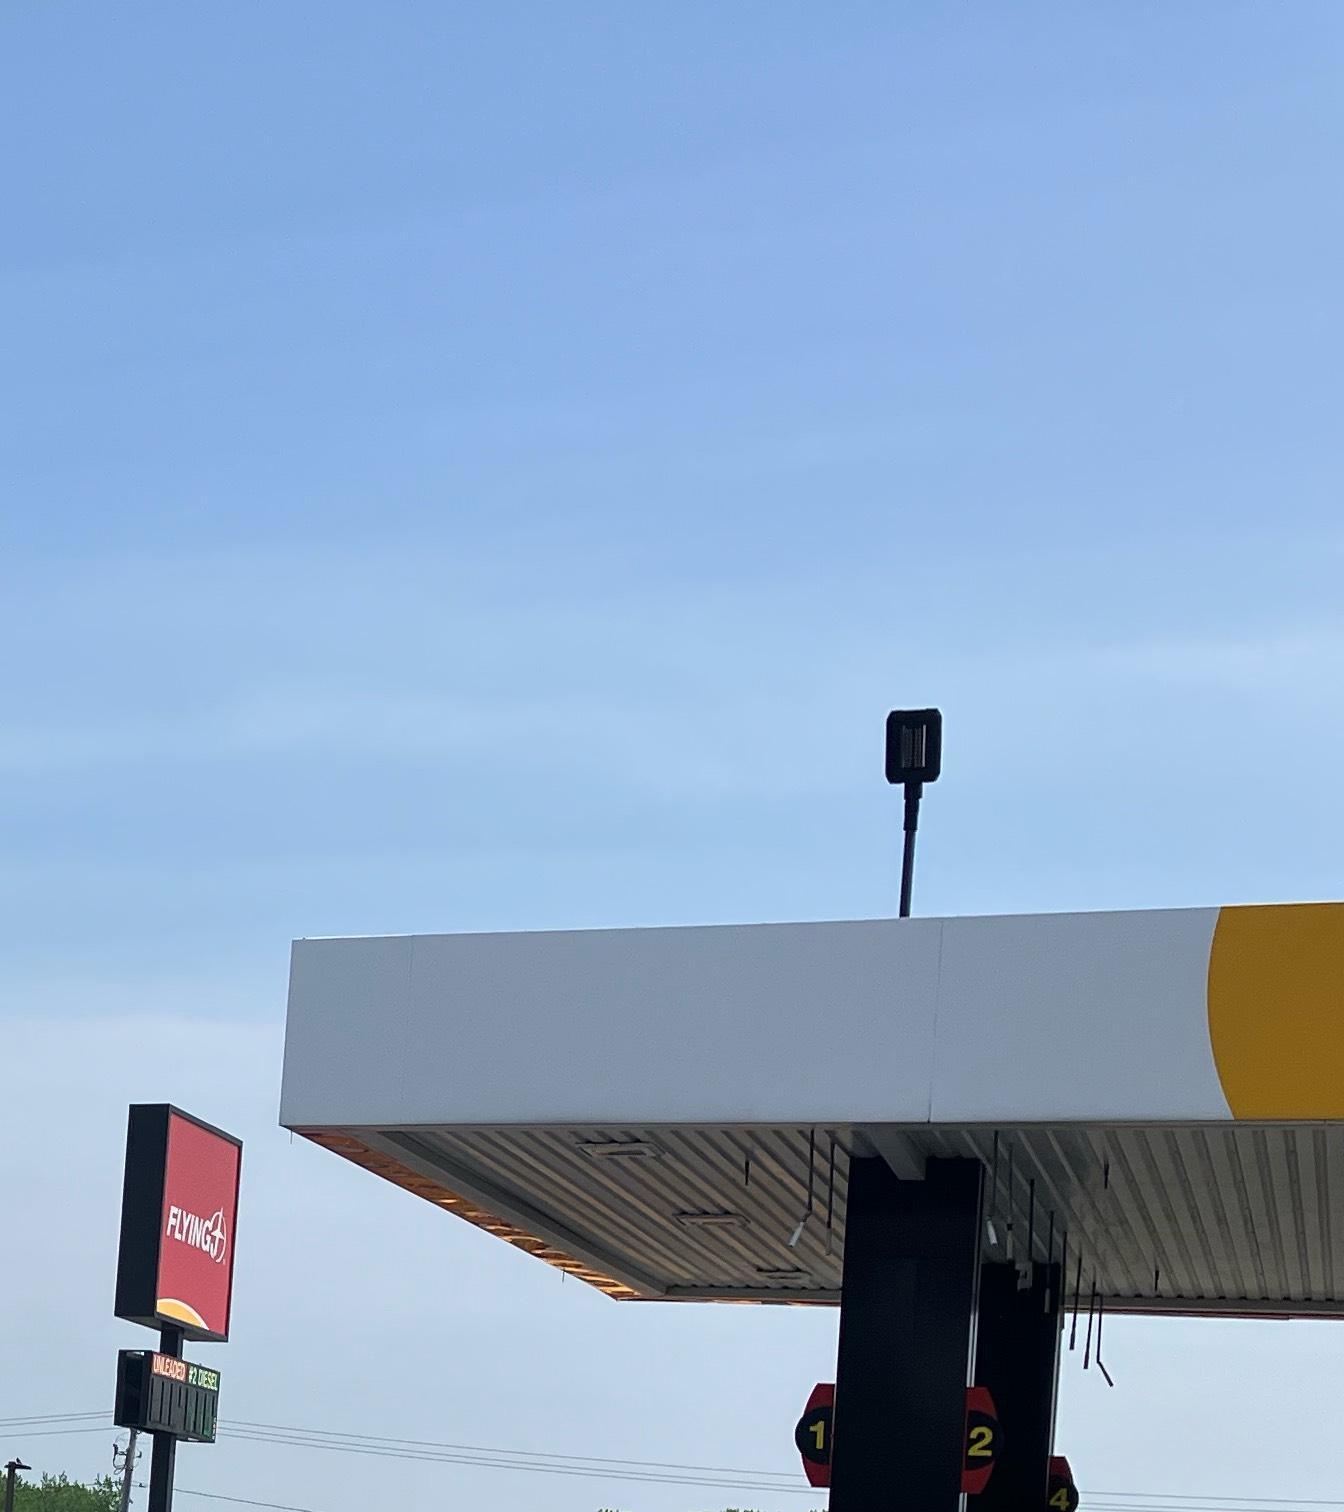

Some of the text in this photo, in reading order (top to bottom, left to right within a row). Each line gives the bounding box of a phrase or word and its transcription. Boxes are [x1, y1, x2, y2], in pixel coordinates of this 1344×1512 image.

[166, 1205, 212, 1254] FLYING
[153, 1353, 186, 1382] UNLEADED
[197, 1368, 218, 1391] DIESEL
[809, 1420, 826, 1450] 1
[967, 1426, 994, 1457] 2
[1049, 1487, 1071, 1512] 4
